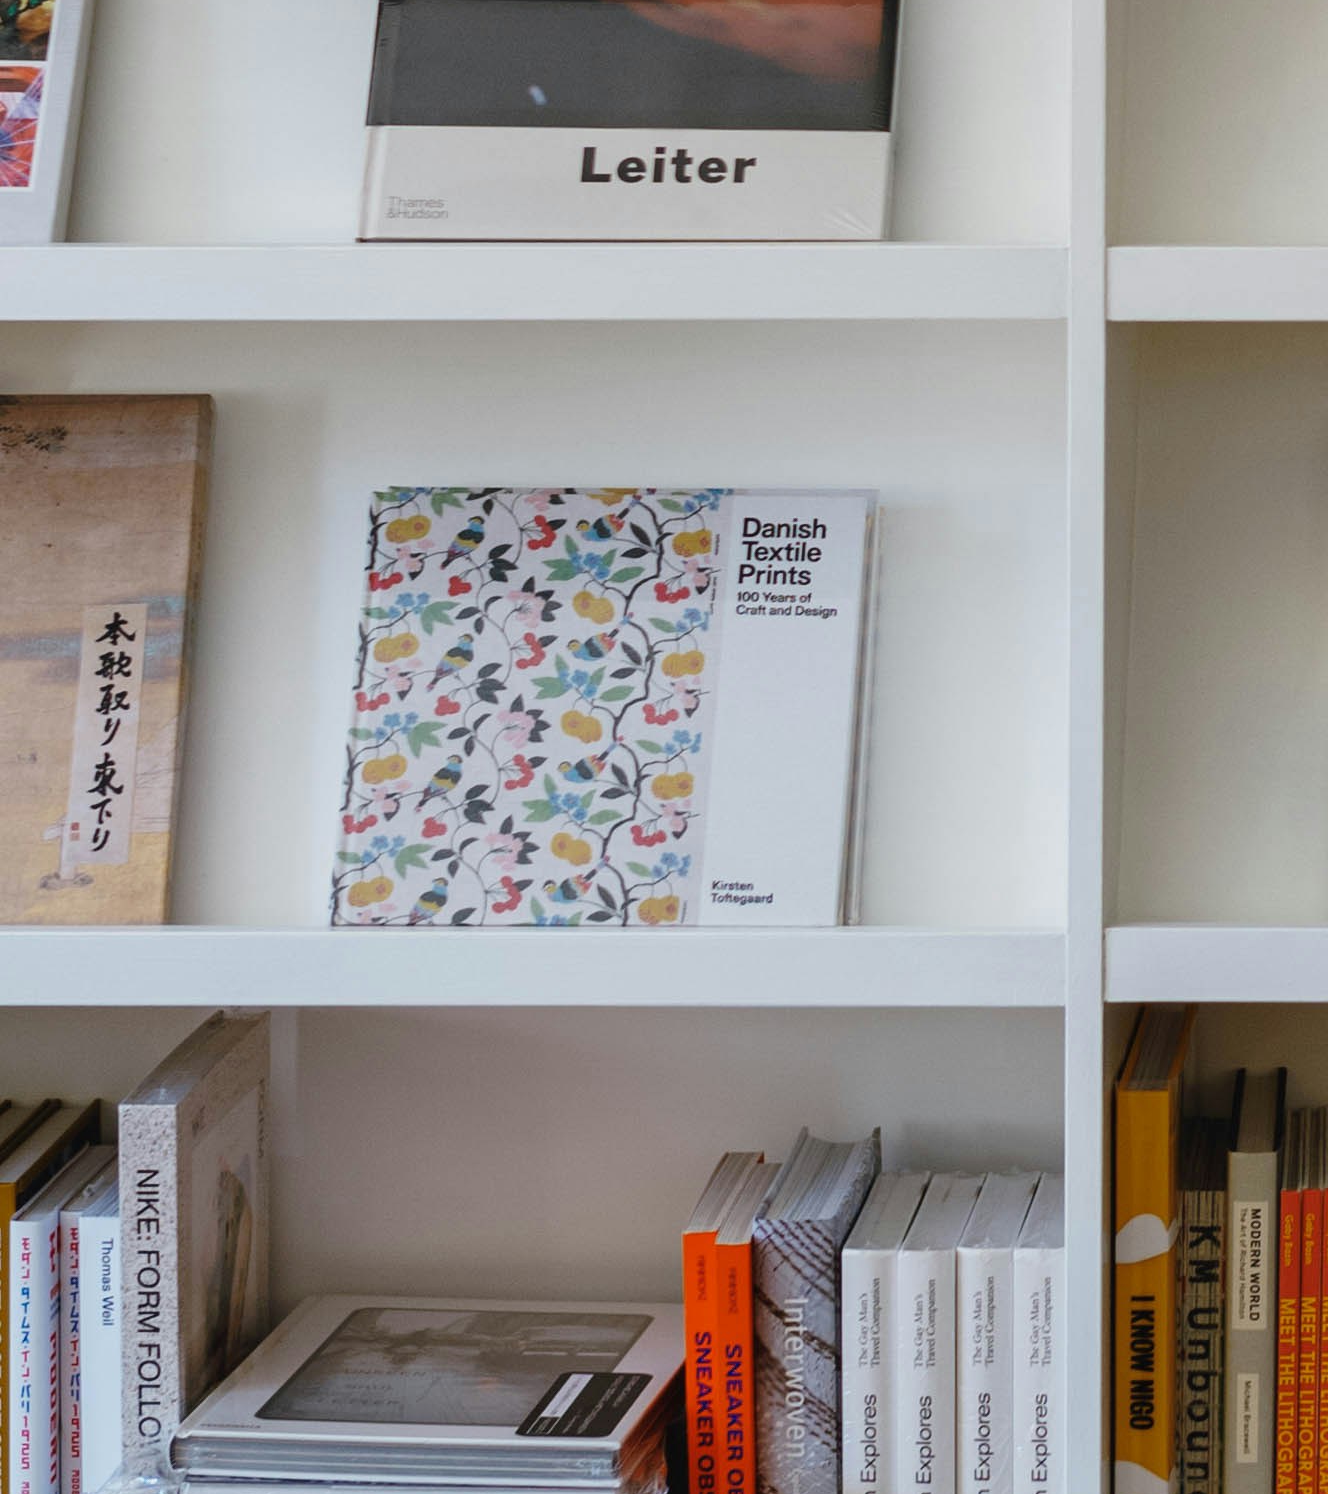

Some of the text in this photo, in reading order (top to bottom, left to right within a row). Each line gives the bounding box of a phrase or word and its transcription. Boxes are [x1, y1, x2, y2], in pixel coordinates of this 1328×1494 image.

[581, 147, 756, 184] Leiter
[742, 517, 827, 542] Danish
[742, 542, 821, 563] Textile
[739, 565, 811, 586] Prints
[136, 1168, 160, 1323] NIKE: FORM
[1130, 1309, 1155, 1372] KNOW
[1130, 1380, 1155, 1430] NIGO
